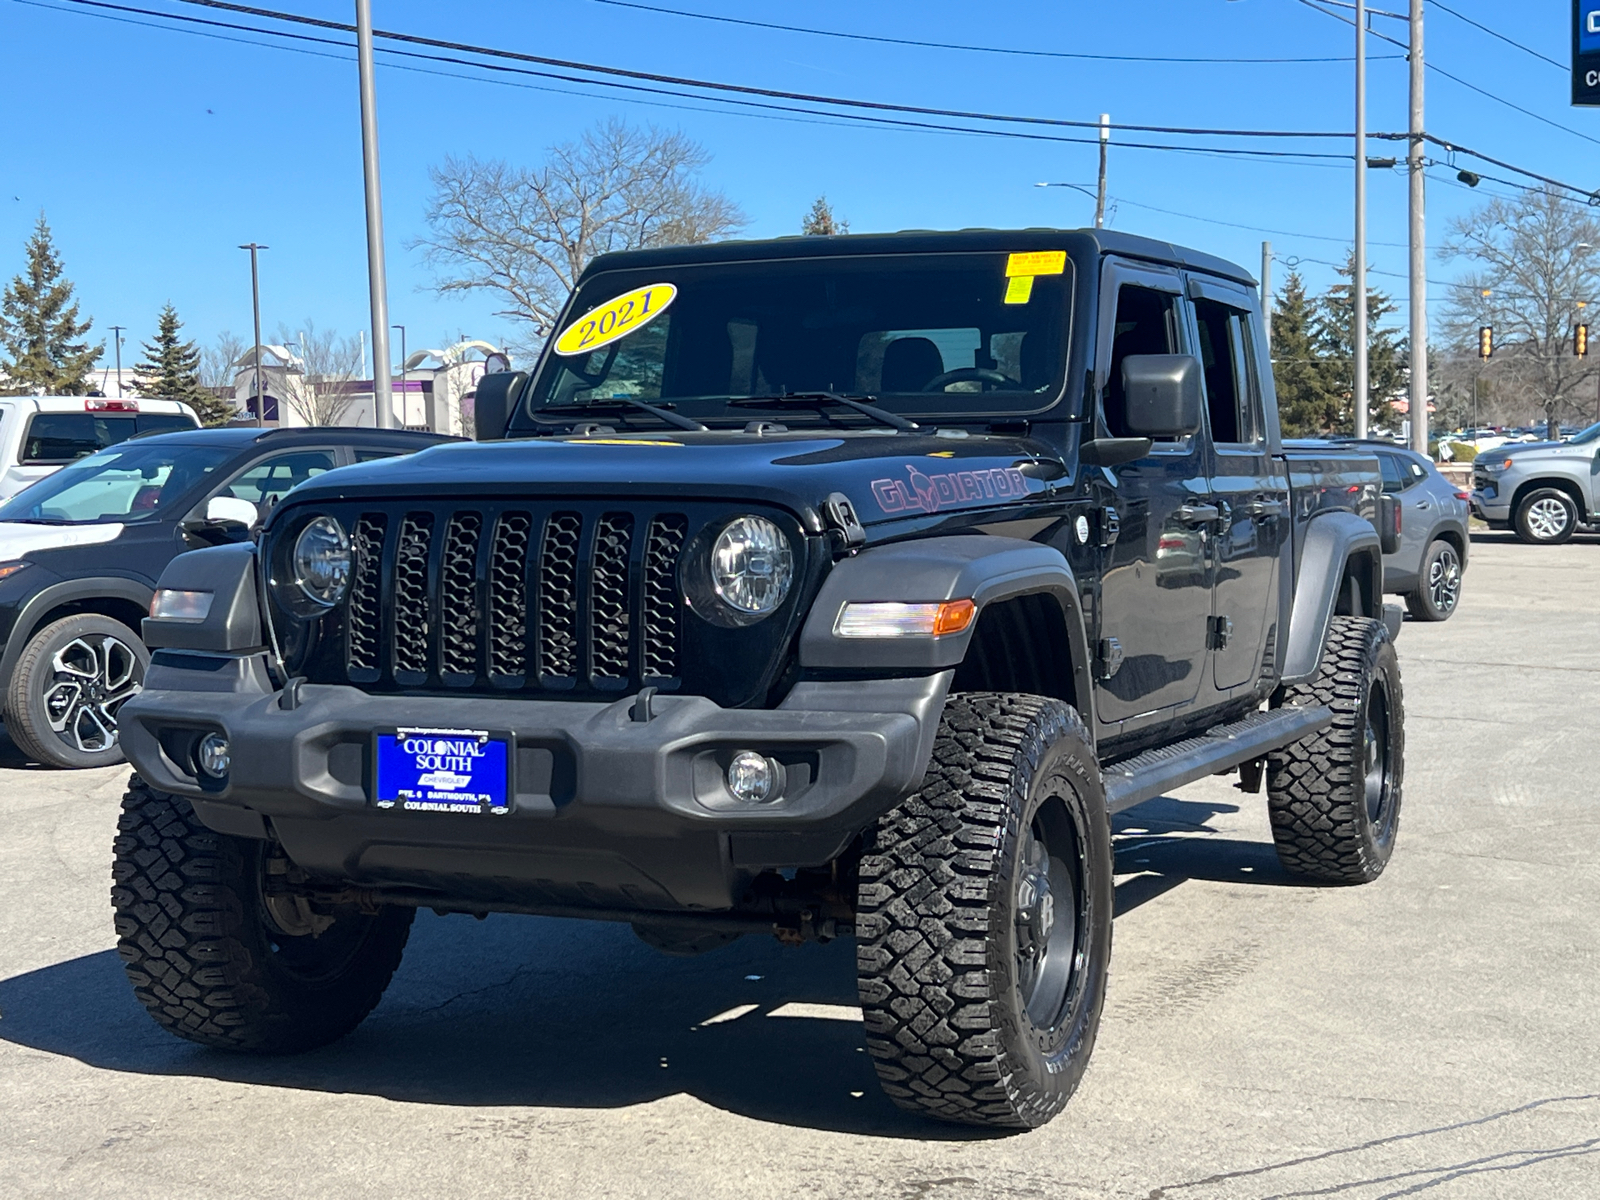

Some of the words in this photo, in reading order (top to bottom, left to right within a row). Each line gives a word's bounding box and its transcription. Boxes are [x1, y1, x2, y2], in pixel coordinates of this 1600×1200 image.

[578, 290, 653, 348] 2021
[403, 739, 486, 757] COLONIAL
[416, 755, 472, 772] SOUTH
[423, 776, 466, 784] CHEVROLET
[404, 801, 450, 812] COLONIAL
[450, 803, 482, 813] SOUTH
